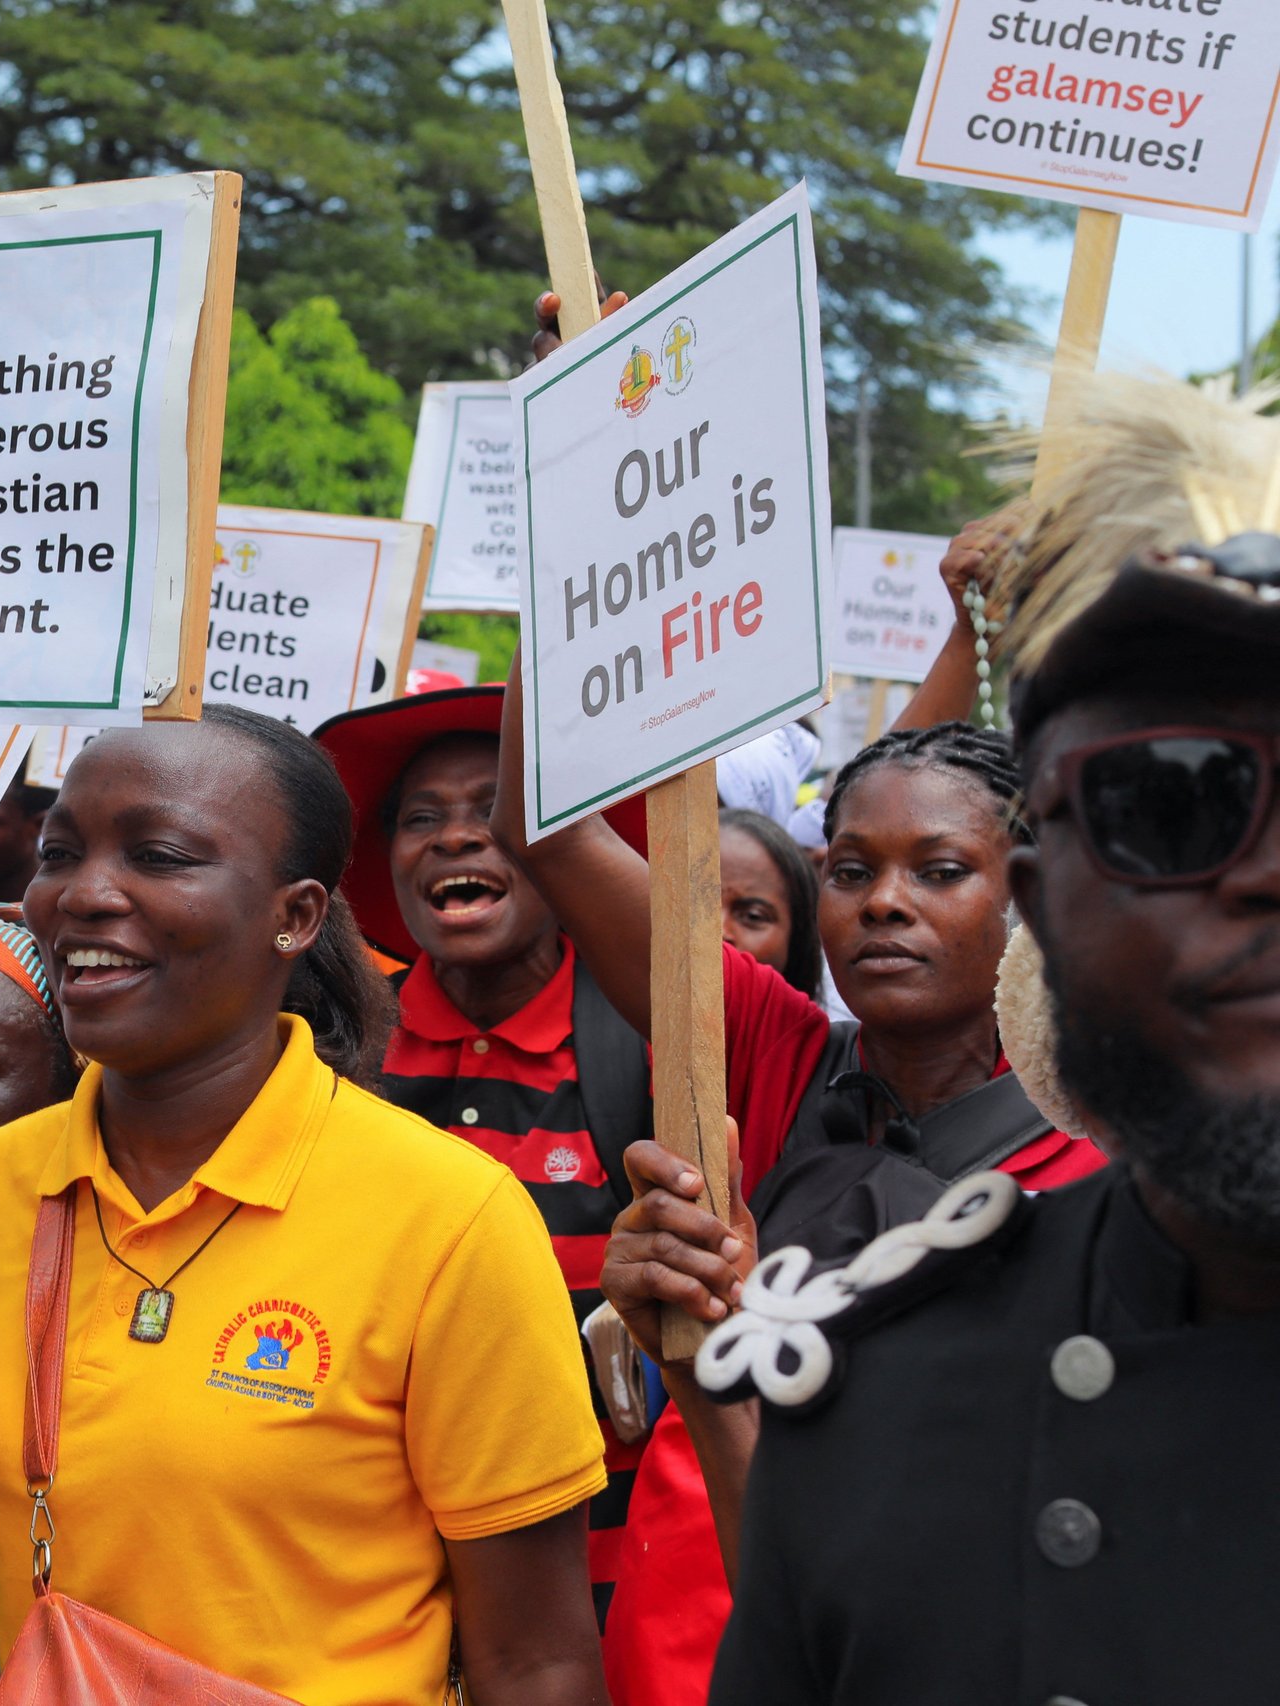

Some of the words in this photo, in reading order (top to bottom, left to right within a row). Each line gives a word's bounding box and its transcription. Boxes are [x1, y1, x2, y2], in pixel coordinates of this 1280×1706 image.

[988, 11, 1186, 64] students
[1198, 31, 1235, 70] if
[987, 62, 1203, 128] galamsey
[966, 112, 1204, 174] continues!
[614, 420, 710, 520] Our
[469, 482, 516, 496] wast
[485, 501, 516, 517] wit
[489, 521, 516, 537] Co
[36, 534, 115, 574] the
[471, 541, 516, 556] defe
[564, 513, 717, 642] Home
[731, 473, 777, 548] is
[495, 564, 519, 581] gr
[873, 576, 916, 597] Our
[210, 581, 309, 617] duate
[843, 598, 913, 622] Home
[581, 645, 643, 718] on
[661, 581, 764, 680] Fire
[881, 630, 927, 651] Fire
[209, 664, 309, 700] clean
[647, 688, 716, 730] StopGalamseyNow
[212, 1312, 247, 1364] CATHOLIC
[248, 1299, 321, 1331] CHARISMATIC
[312, 1329, 331, 1385] RENEWAL
